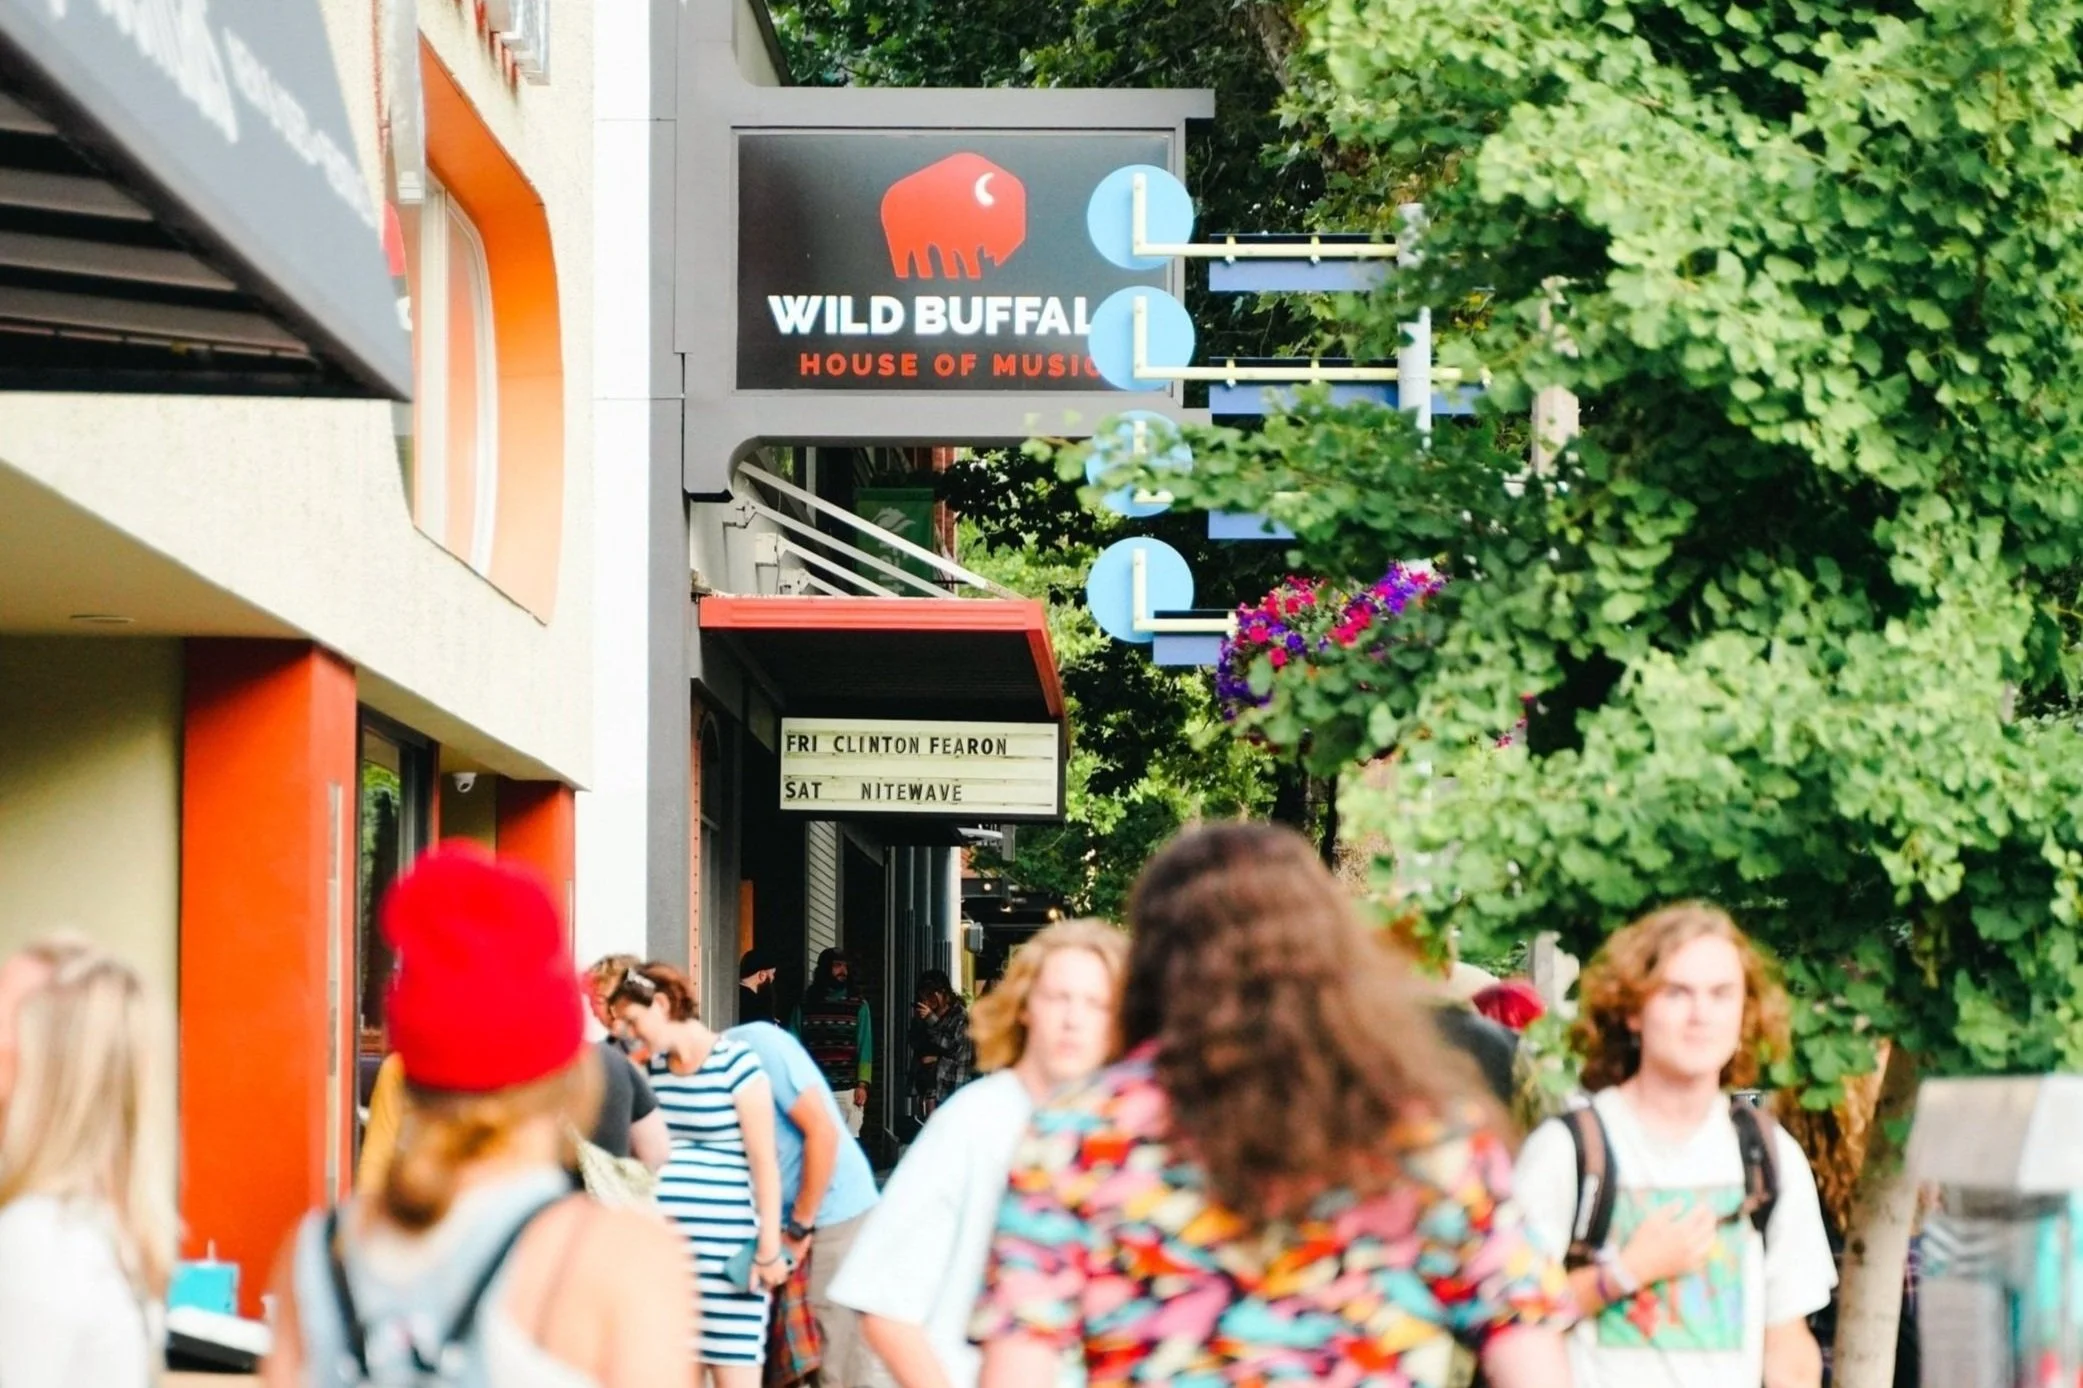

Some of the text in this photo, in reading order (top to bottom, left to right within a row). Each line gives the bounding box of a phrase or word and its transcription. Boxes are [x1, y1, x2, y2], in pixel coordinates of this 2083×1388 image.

[767, 295, 1092, 336] WILD BUFFAL
[800, 352, 917, 377] HOUSE
[933, 352, 977, 378] OF
[786, 734, 1008, 756] FRI CLINTON FEARON
[785, 781, 963, 802] SAT NITEWAVE
